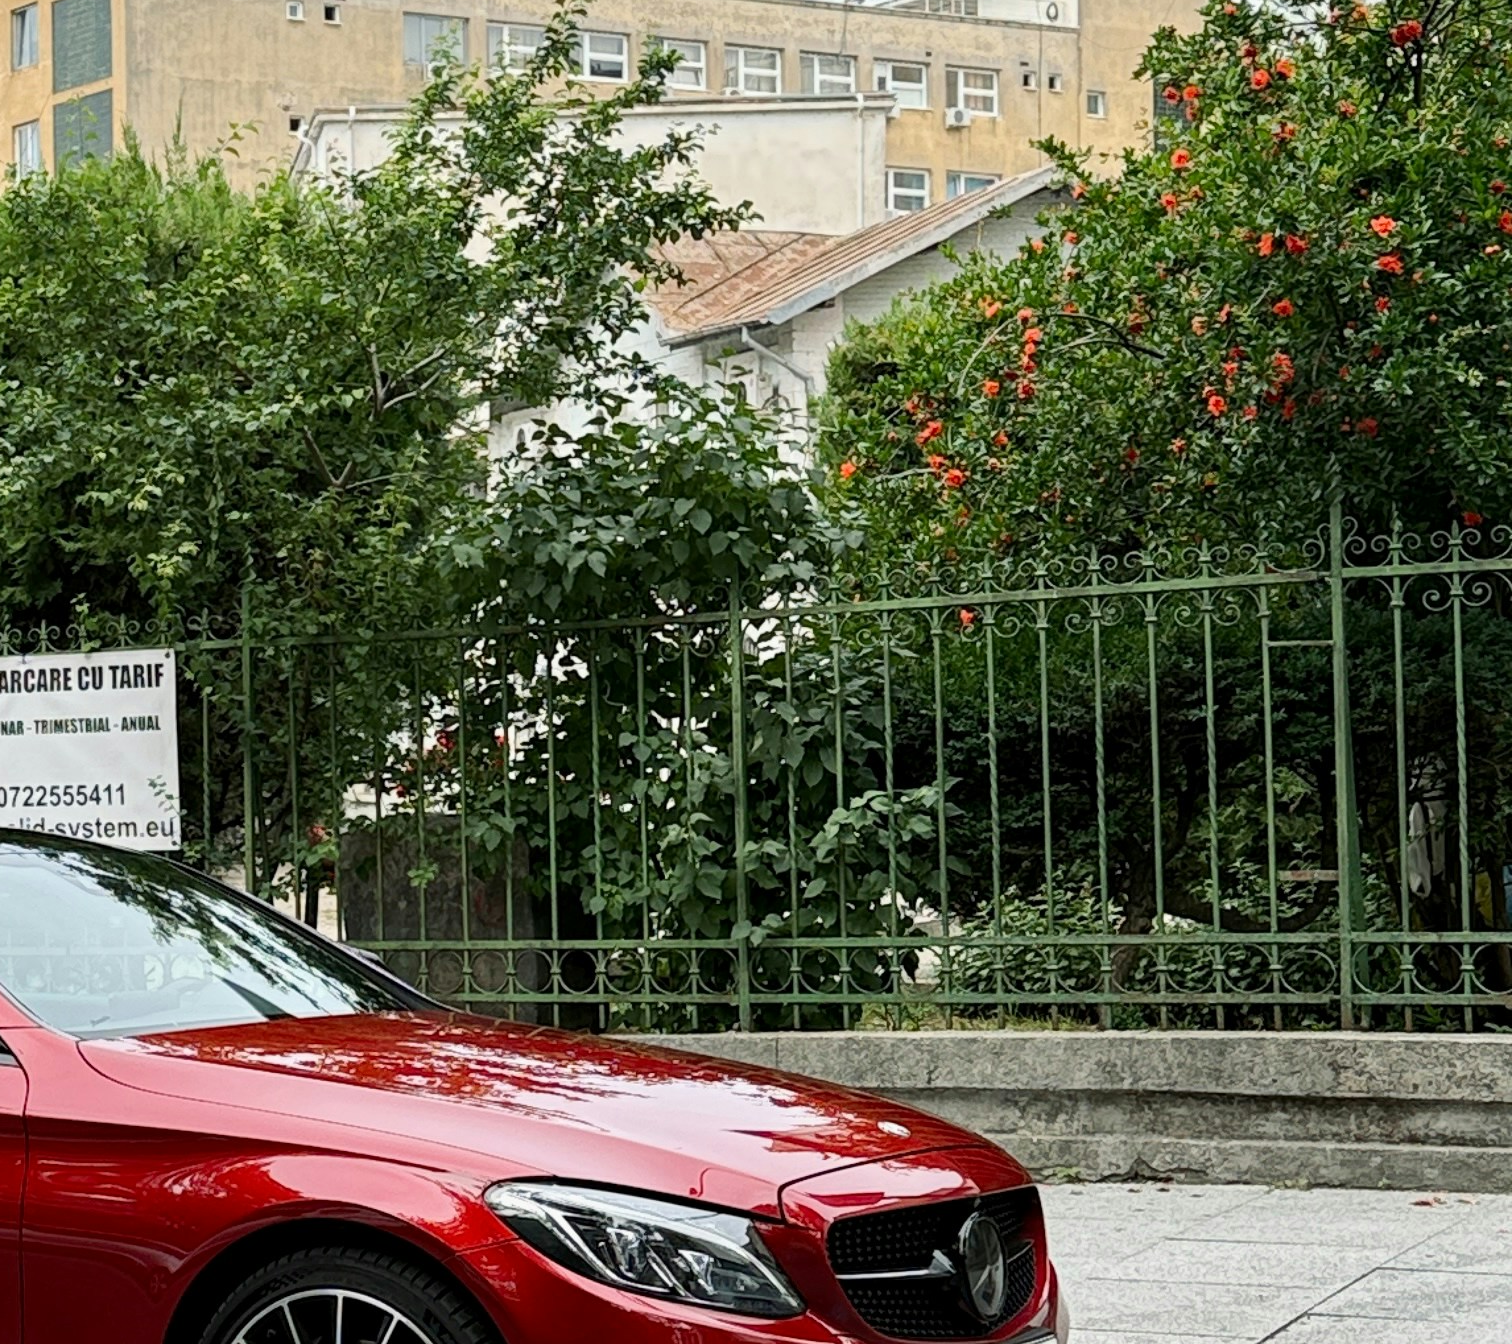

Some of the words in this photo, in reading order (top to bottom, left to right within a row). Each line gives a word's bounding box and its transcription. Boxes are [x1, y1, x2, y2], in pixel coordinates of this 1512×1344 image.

[77, 666, 103, 690] CU
[108, 663, 164, 689] TARIF
[34, 717, 111, 735] TRIMESTRIAL
[121, 715, 161, 732] ANUAL
